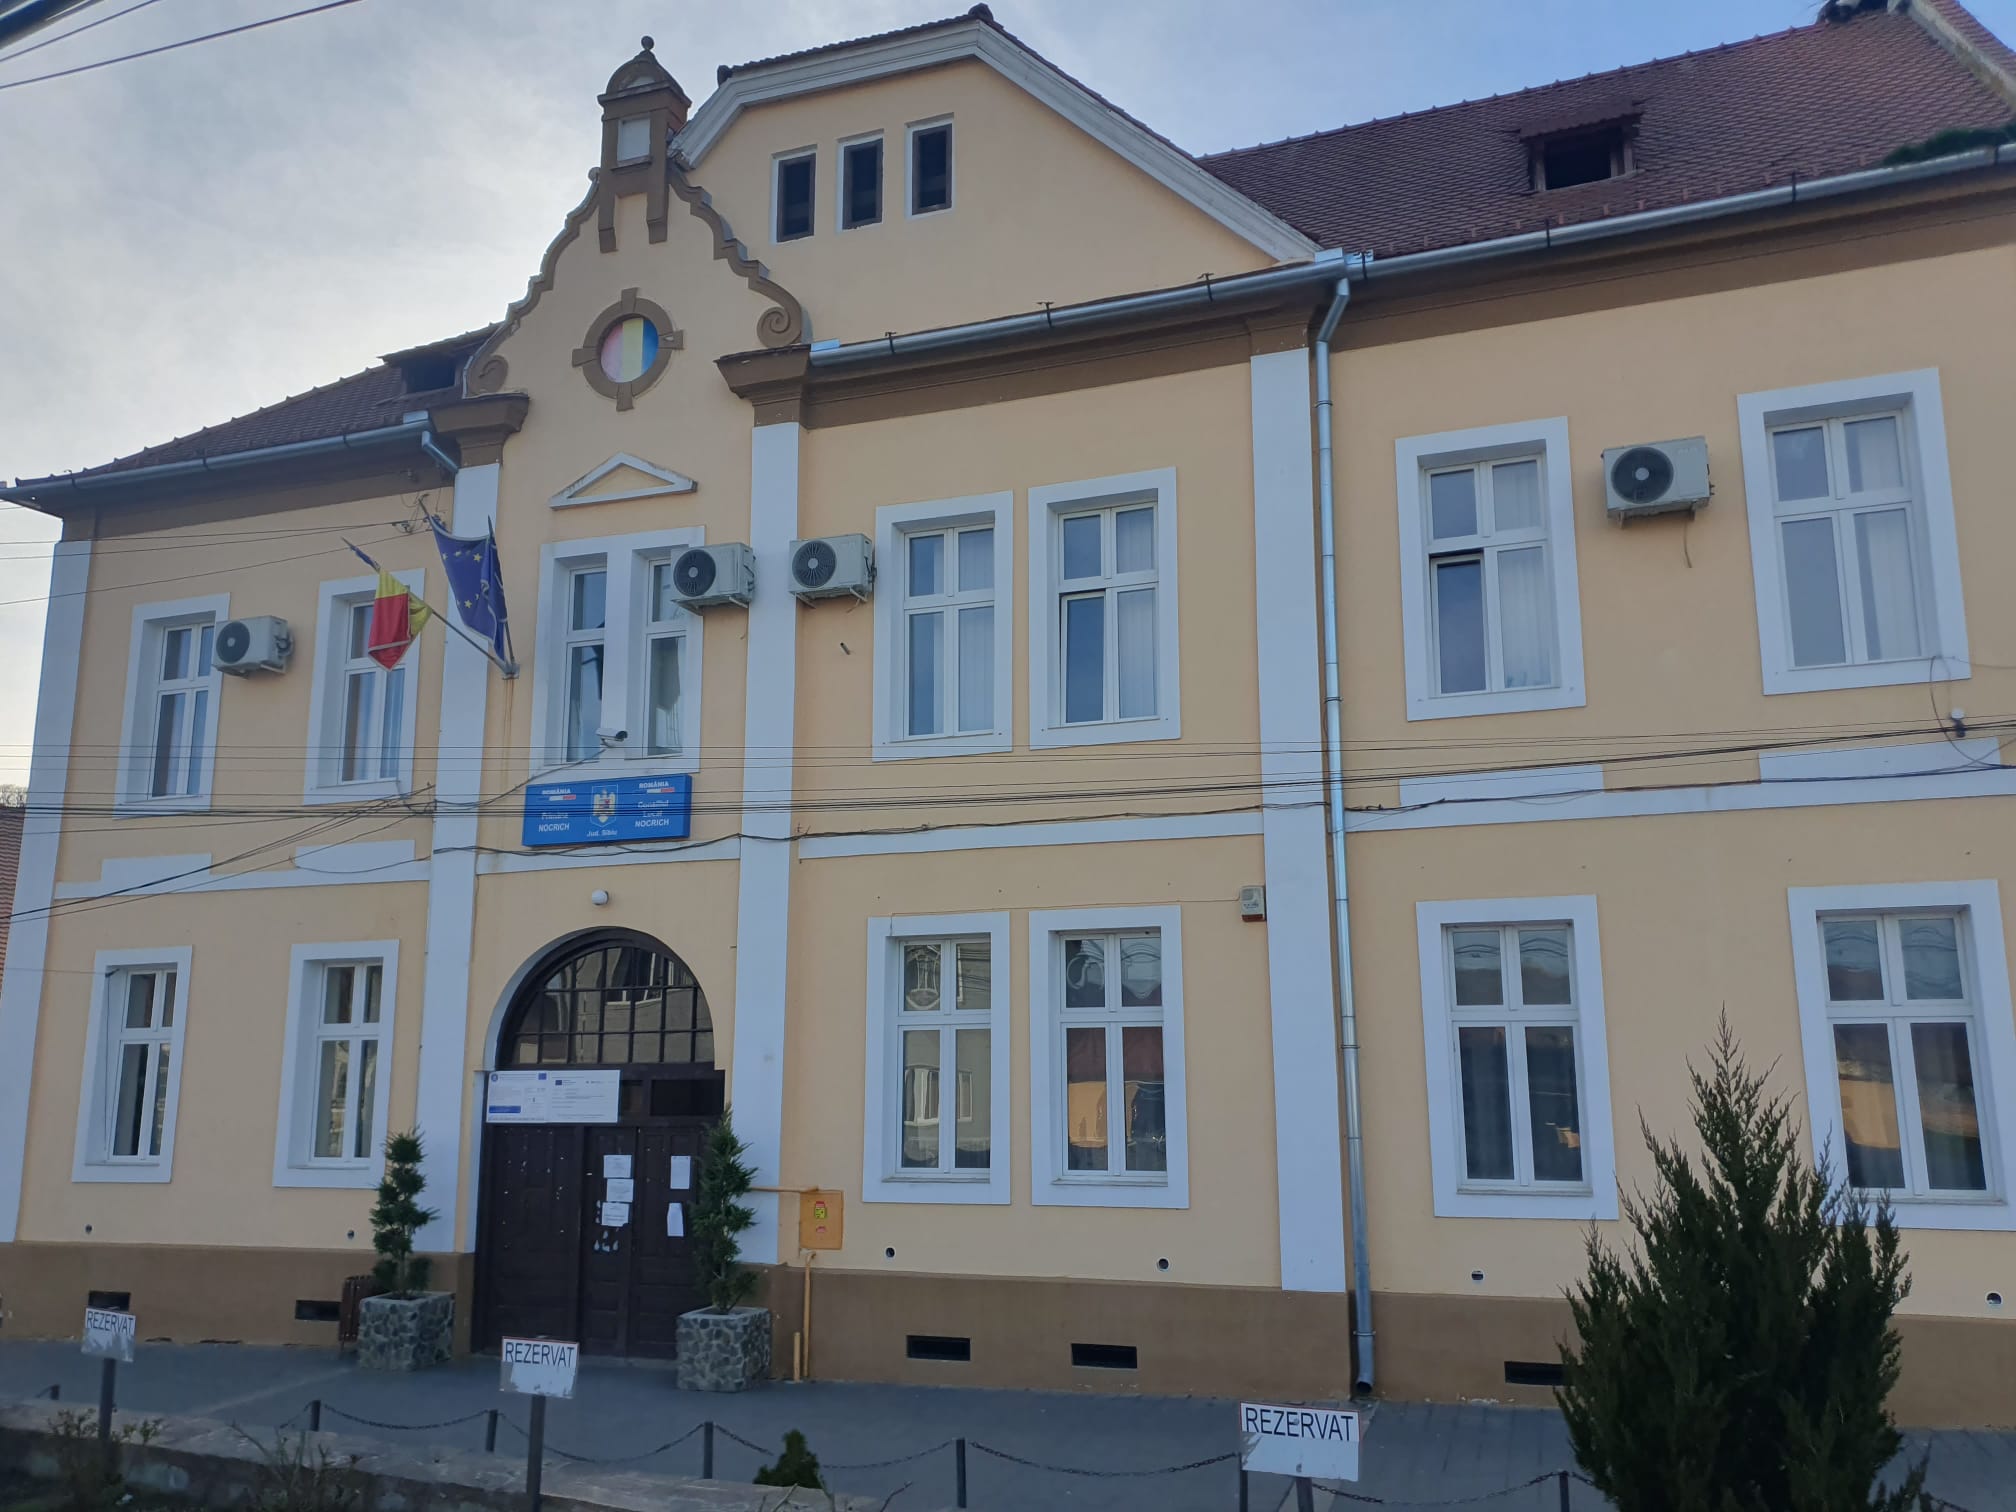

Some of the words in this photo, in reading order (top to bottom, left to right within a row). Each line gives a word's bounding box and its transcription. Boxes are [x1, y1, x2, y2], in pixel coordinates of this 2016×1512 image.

[538, 822, 570, 832] NOCRICH
[634, 818, 670, 828] NOCRICH
[86, 1310, 134, 1336] REZERVAT
[505, 1342, 575, 1368] REZERVAT
[1245, 1407, 1354, 1442] REZERVAT
